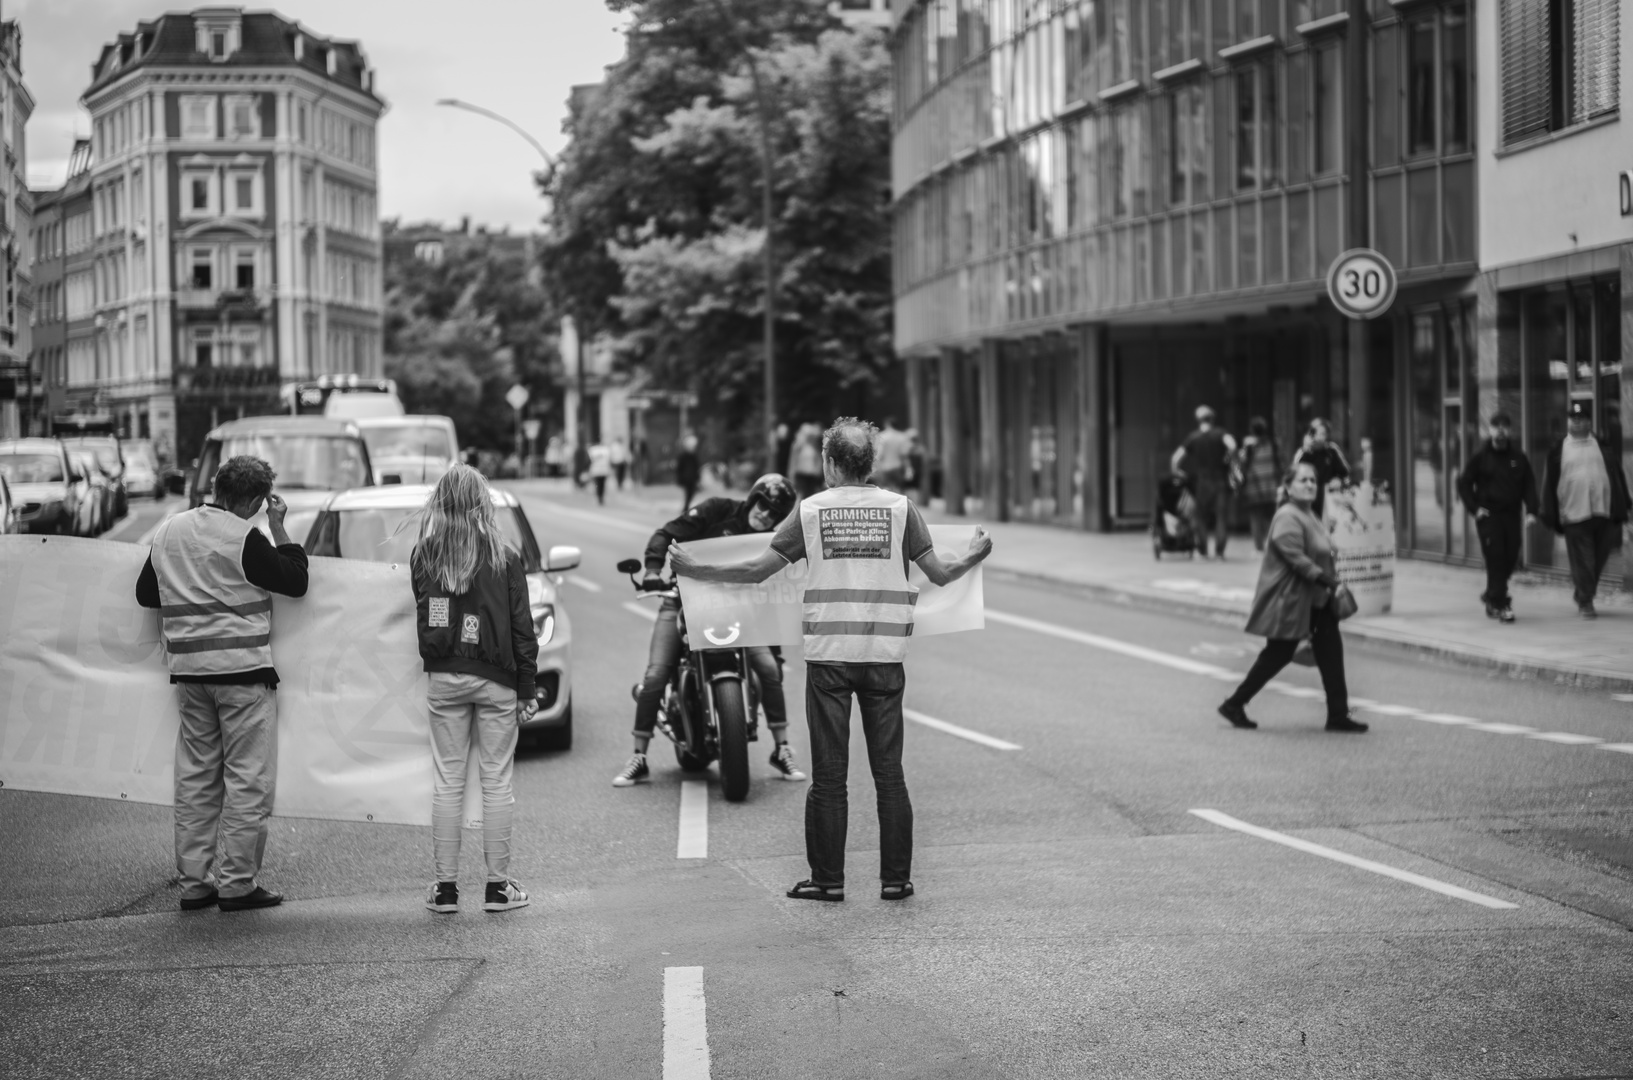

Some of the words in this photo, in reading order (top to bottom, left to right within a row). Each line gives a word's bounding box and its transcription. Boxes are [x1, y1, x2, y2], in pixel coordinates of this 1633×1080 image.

[1344, 269, 1380, 298] 30
[822, 509, 890, 521] KRIMINELL
[854, 521, 889, 529] Regierung,
